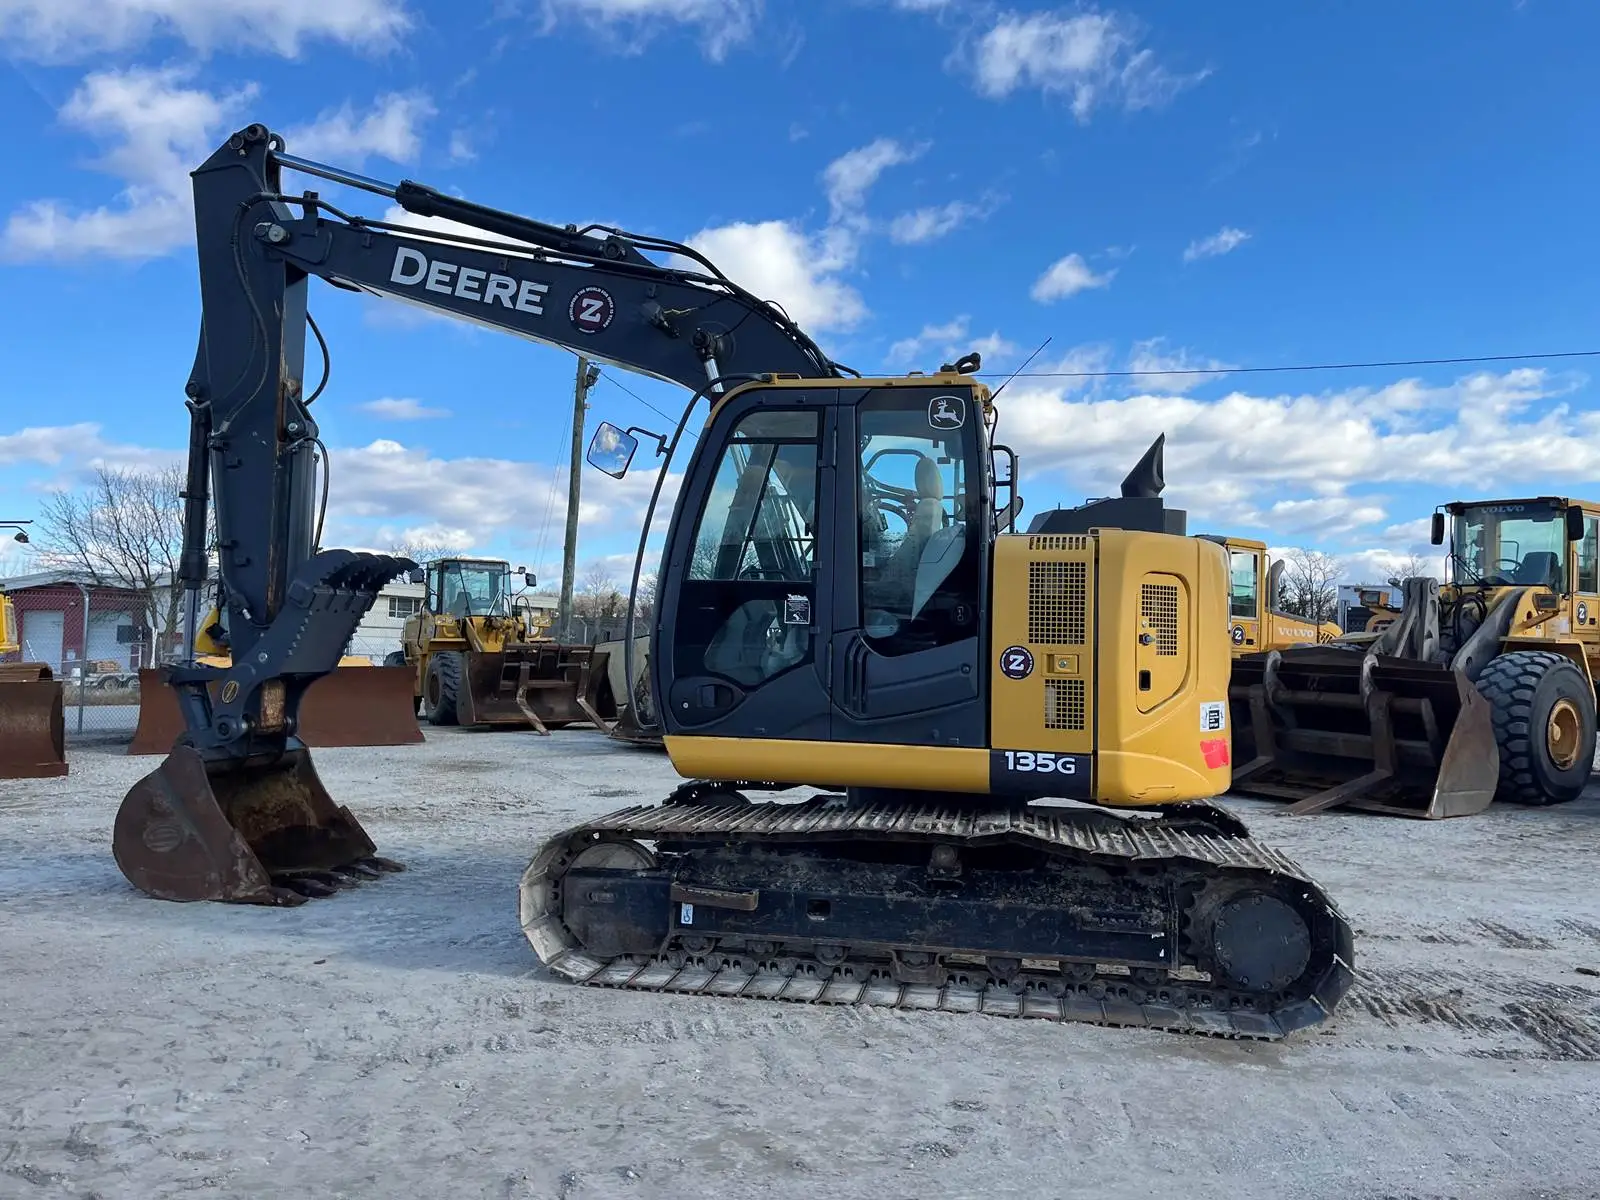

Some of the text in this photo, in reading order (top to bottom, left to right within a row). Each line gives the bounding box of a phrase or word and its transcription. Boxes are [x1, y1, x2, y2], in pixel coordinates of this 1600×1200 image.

[390, 246, 549, 315] DEERE
[580, 298, 604, 323] Z
[1480, 505, 1525, 514] VOLVO
[1579, 607, 1585, 619] Z
[1235, 630, 1242, 640] Z
[1278, 627, 1314, 638] VOLVO
[1009, 654, 1025, 671] Z
[1004, 751, 1076, 775] 135G
